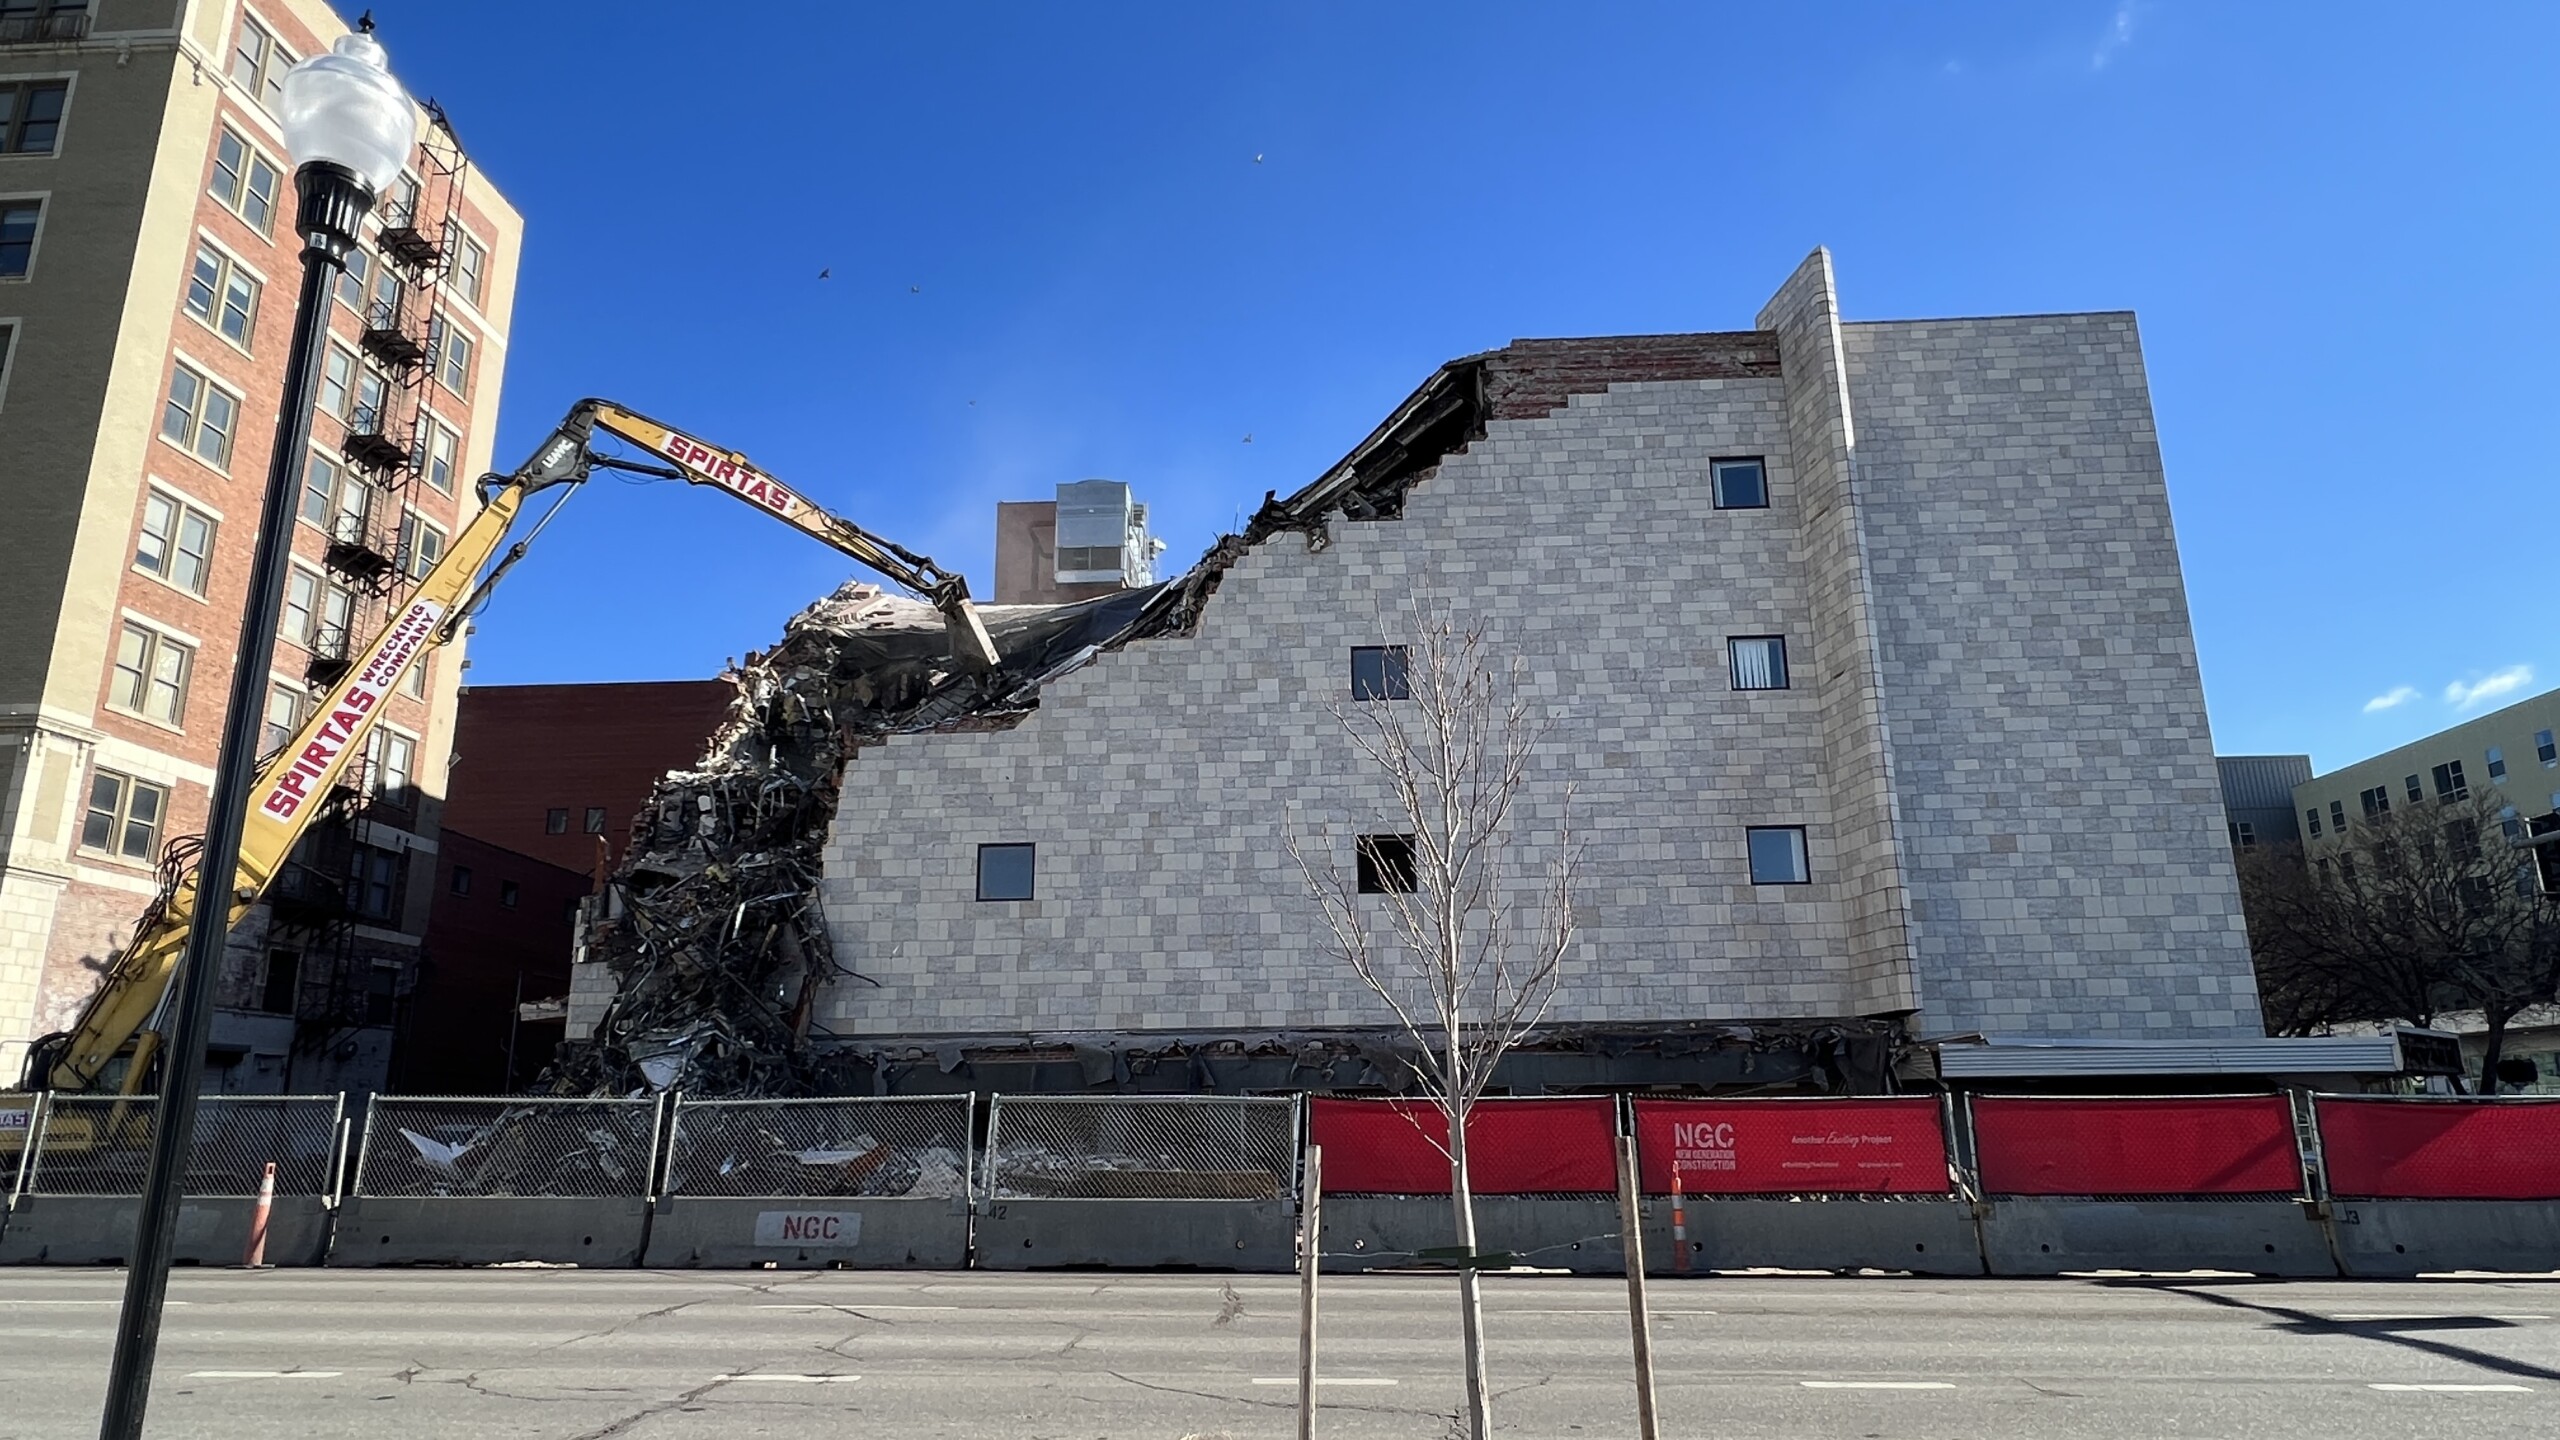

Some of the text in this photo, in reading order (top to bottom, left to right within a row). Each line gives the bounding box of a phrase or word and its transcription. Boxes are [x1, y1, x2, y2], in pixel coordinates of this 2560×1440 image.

[667, 435, 790, 512] SPIRTAS
[359, 604, 426, 684] WRECKING
[376, 612, 435, 687] COMPANY
[264, 686, 377, 818] SPIRTAS
[1674, 1122, 1735, 1148] NGC
[783, 1215, 841, 1240] NGC
[989, 1205, 1007, 1220] 42
